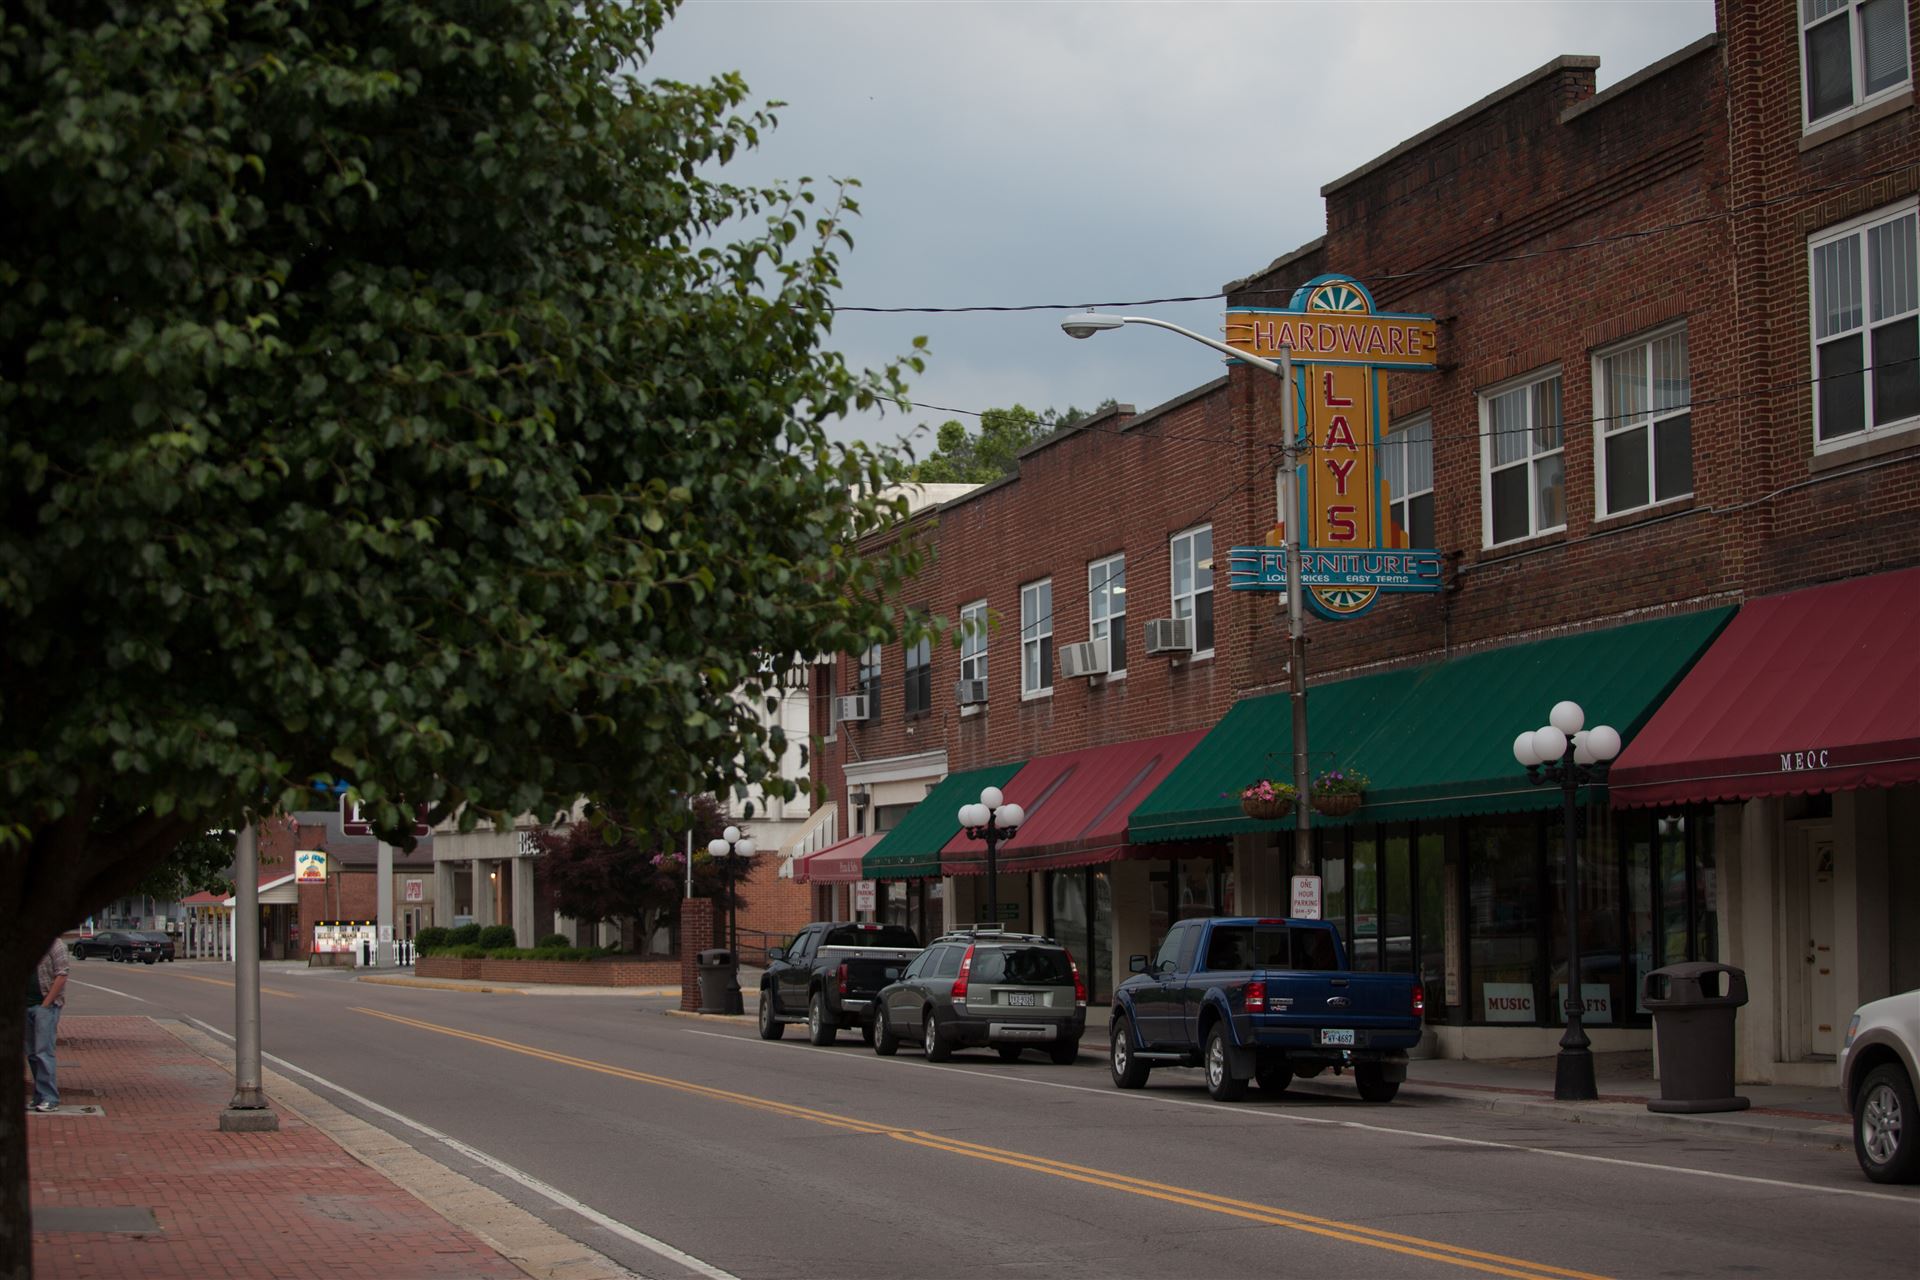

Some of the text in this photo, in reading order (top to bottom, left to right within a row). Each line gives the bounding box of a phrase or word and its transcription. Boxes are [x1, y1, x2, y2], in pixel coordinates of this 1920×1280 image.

[1254, 320, 1421, 357] HARDWARE
[1324, 370, 1359, 541] LAYS
[1300, 574, 1330, 583] RICES
[1346, 574, 1371, 583] EASY
[1375, 575, 1409, 584] TERMS
[1779, 750, 1829, 771] MEOC
[862, 882, 870, 890] NO
[1300, 881, 1313, 889] ONE
[1488, 998, 1531, 1011] MUSIC
